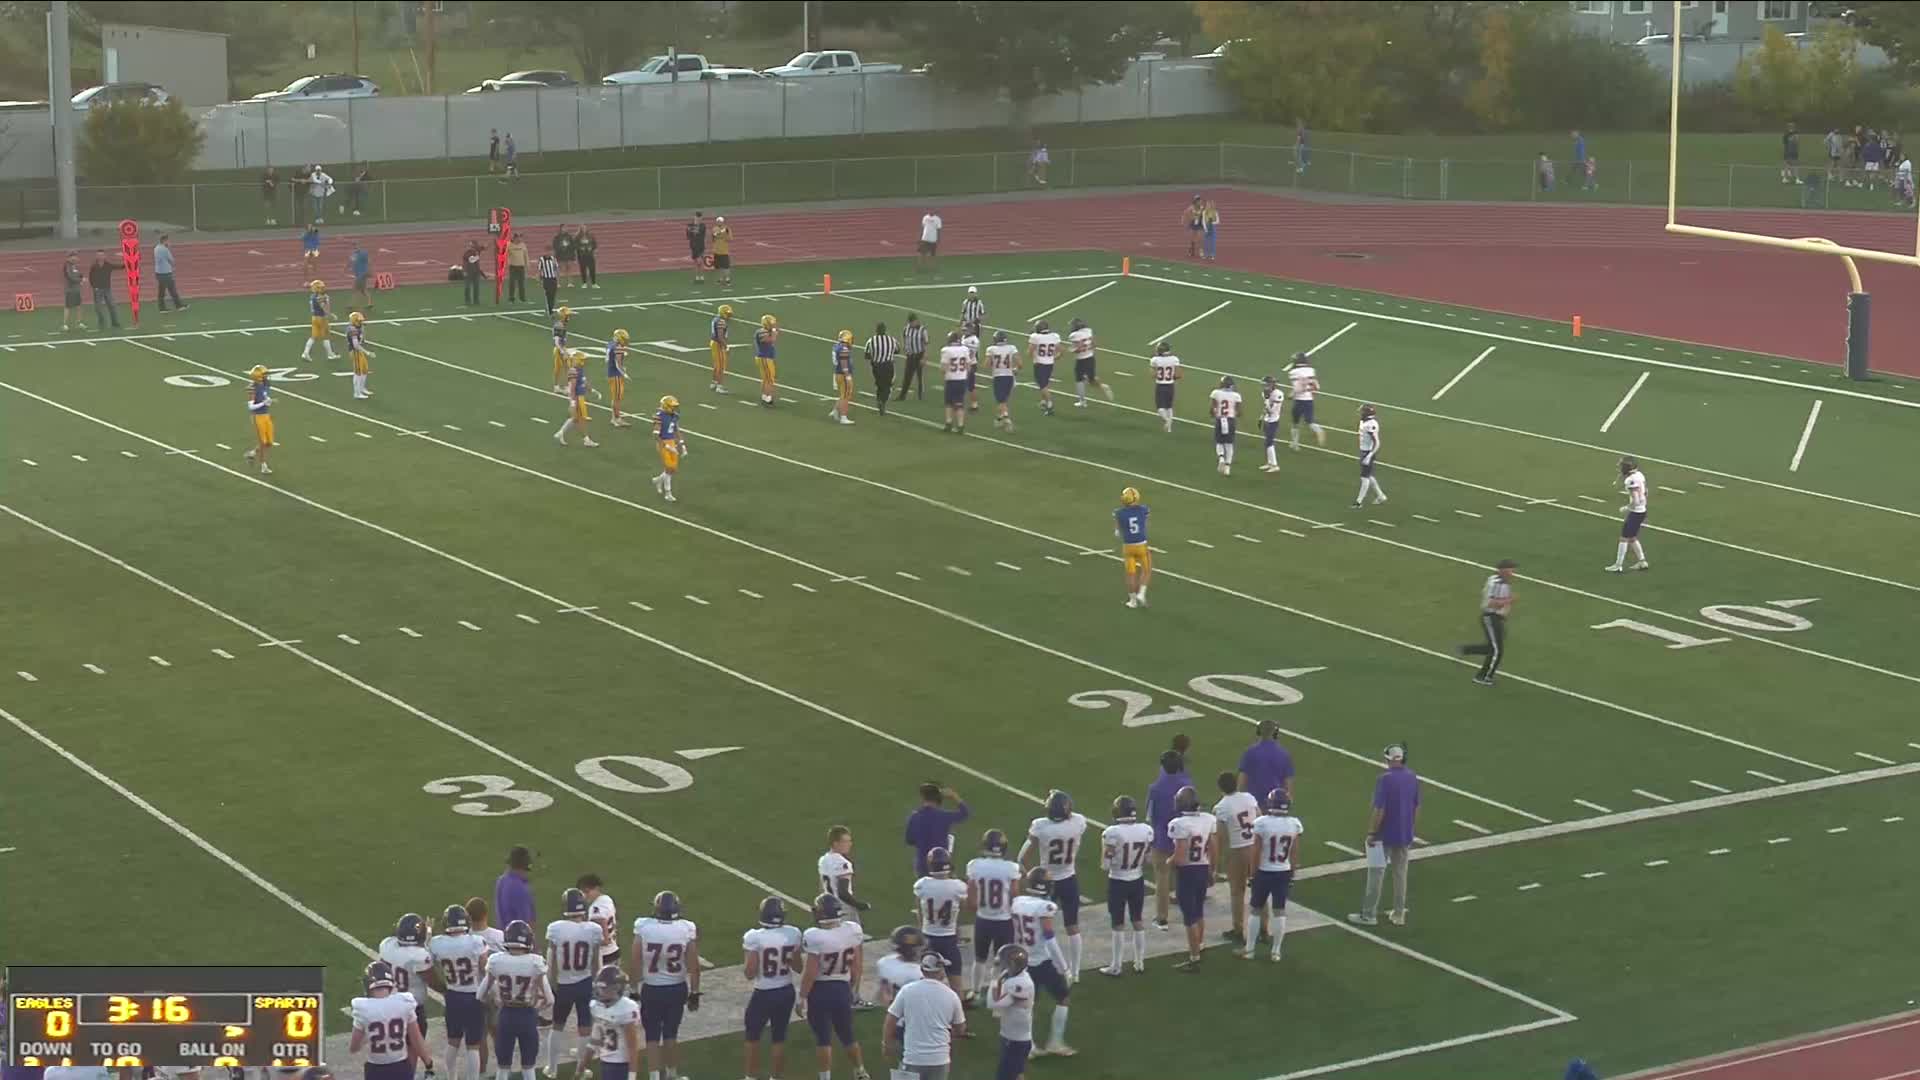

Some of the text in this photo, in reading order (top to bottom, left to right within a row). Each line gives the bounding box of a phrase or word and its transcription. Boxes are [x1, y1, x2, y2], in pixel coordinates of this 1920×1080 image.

[704, 256, 715, 268] G
[379, 274, 392, 288] 10
[18, 296, 32, 310] 20
[993, 354, 1011, 369] 74
[1038, 343, 1055, 357] 66
[950, 357, 966, 372] 59
[1157, 367, 1173, 381] 33
[1220, 400, 1229, 417] 2
[1128, 517, 1140, 534] 5
[1591, 605, 1813, 649] 10
[1067, 674, 1303, 728] 20
[421, 755, 694, 816] 30
[1237, 811, 1254, 840] 5
[1050, 838, 1074, 865] 21
[1121, 842, 1146, 869] 17
[1268, 835, 1292, 863] 13
[978, 879, 1004, 909] 18
[926, 898, 953, 926] 14
[562, 941, 589, 971] 10
[646, 943, 684, 974] 72
[763, 945, 796, 978] 65
[823, 947, 855, 976] 76
[442, 957, 473, 986] 32
[499, 974, 532, 1002] 27
[368, 1018, 404, 1053] 29
